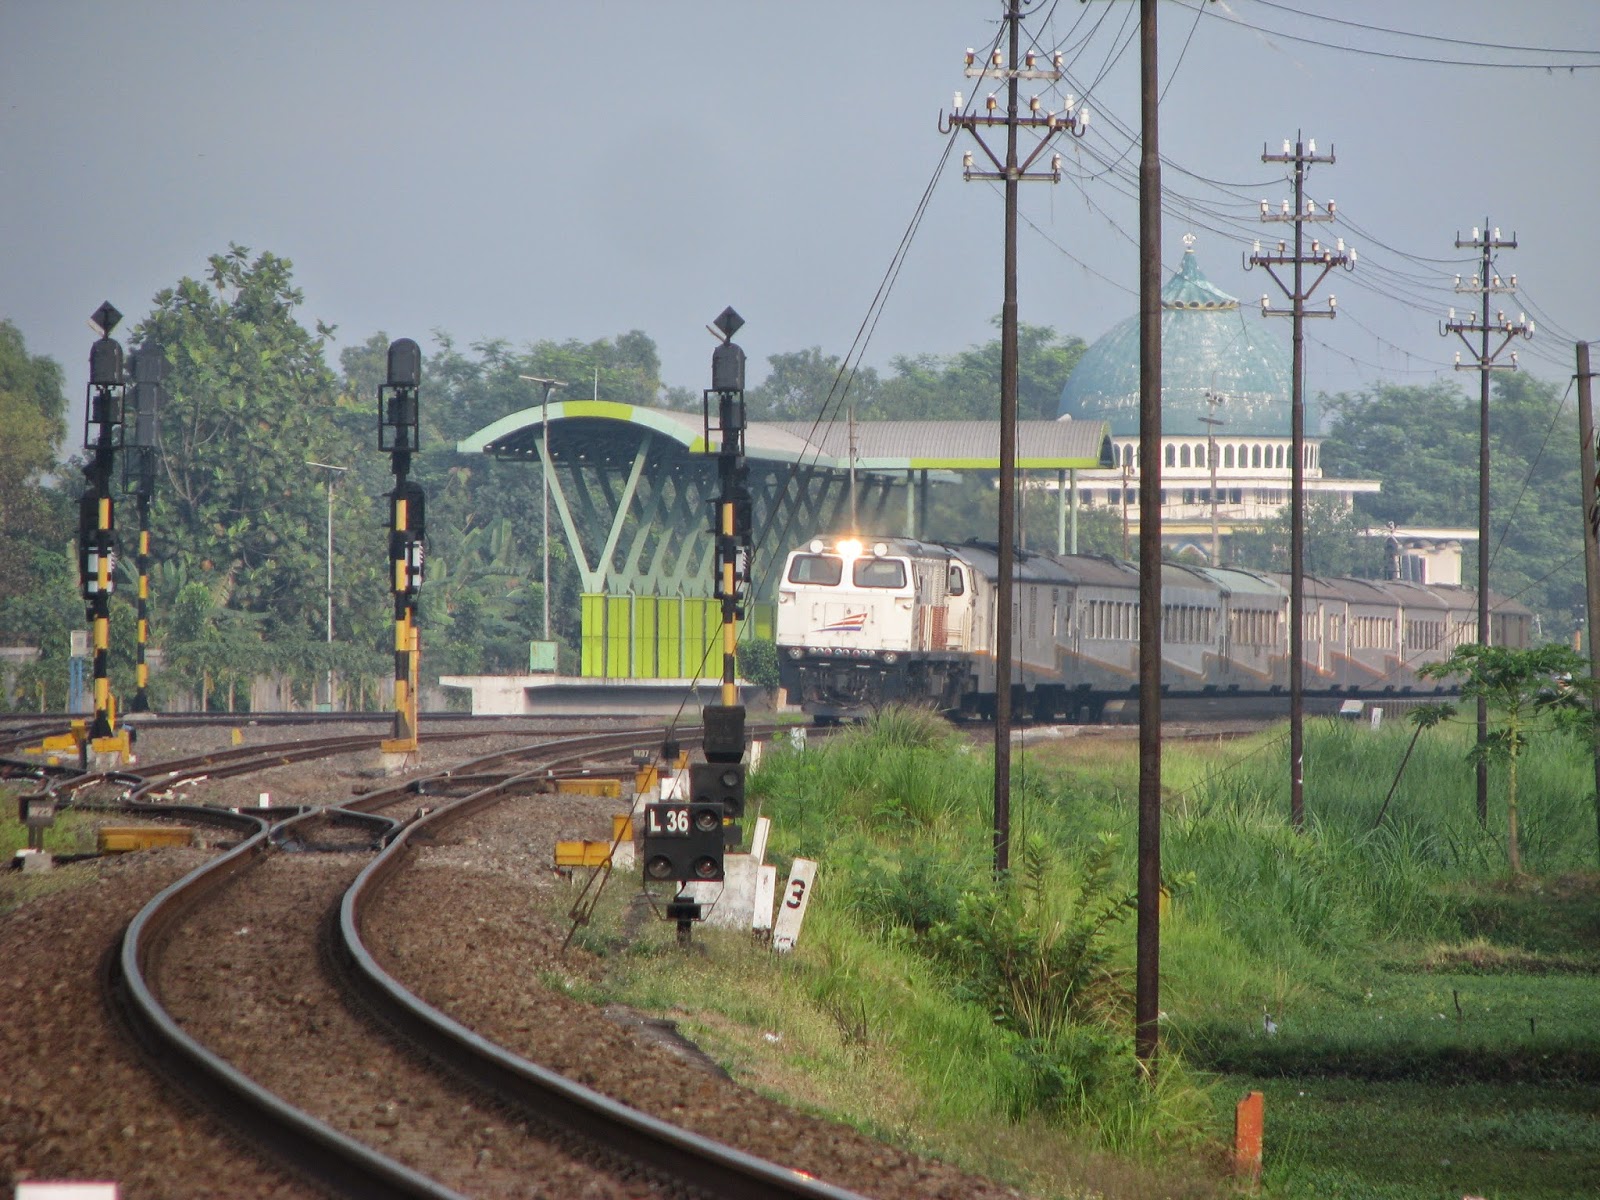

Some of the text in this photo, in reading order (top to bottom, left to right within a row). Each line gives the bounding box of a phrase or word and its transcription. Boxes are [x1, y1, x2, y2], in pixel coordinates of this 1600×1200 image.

[650, 810, 689, 832] L 36
[786, 879, 806, 909] 3
